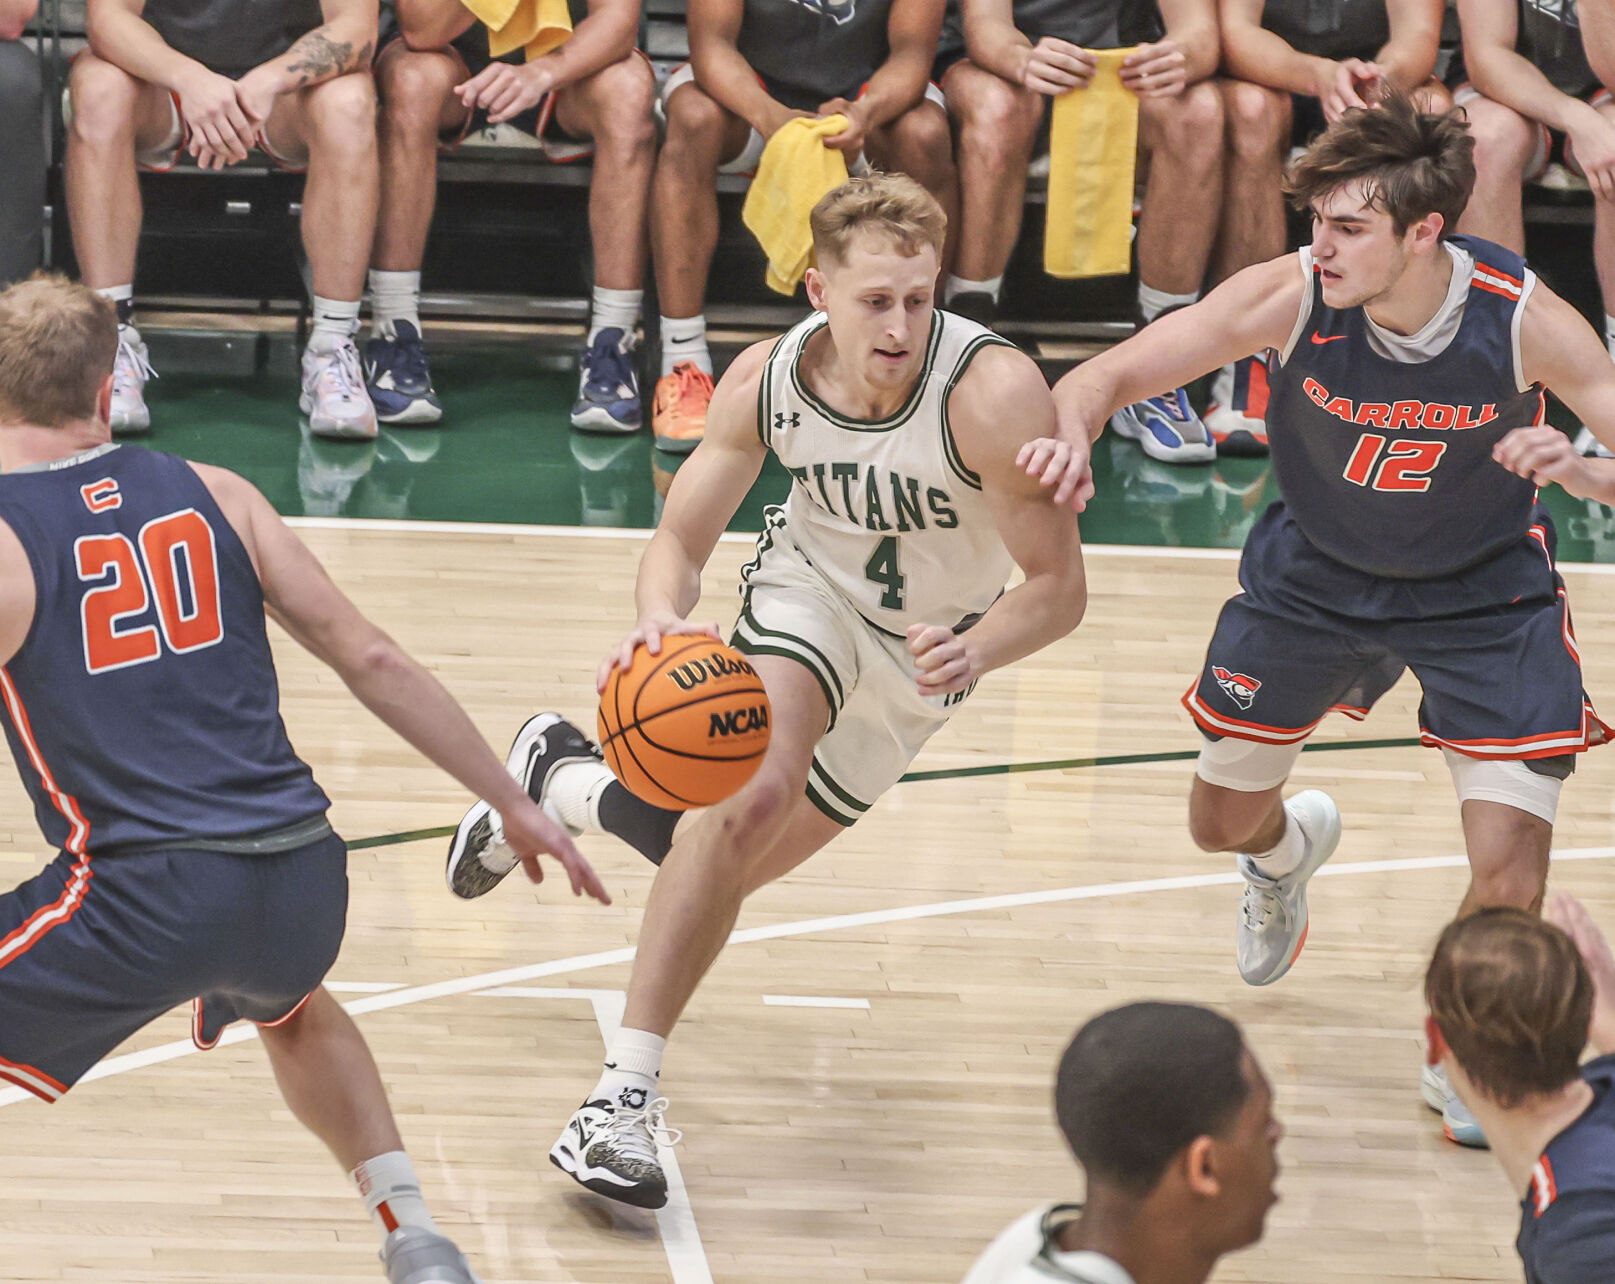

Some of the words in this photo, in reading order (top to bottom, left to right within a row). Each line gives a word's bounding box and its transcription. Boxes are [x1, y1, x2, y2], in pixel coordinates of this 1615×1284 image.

[1302, 377, 1498, 430] CARROLL
[1342, 433, 1447, 492] 12
[74, 508, 224, 675] 20
[864, 535, 907, 611] 4
[707, 705, 768, 738] NCAA
